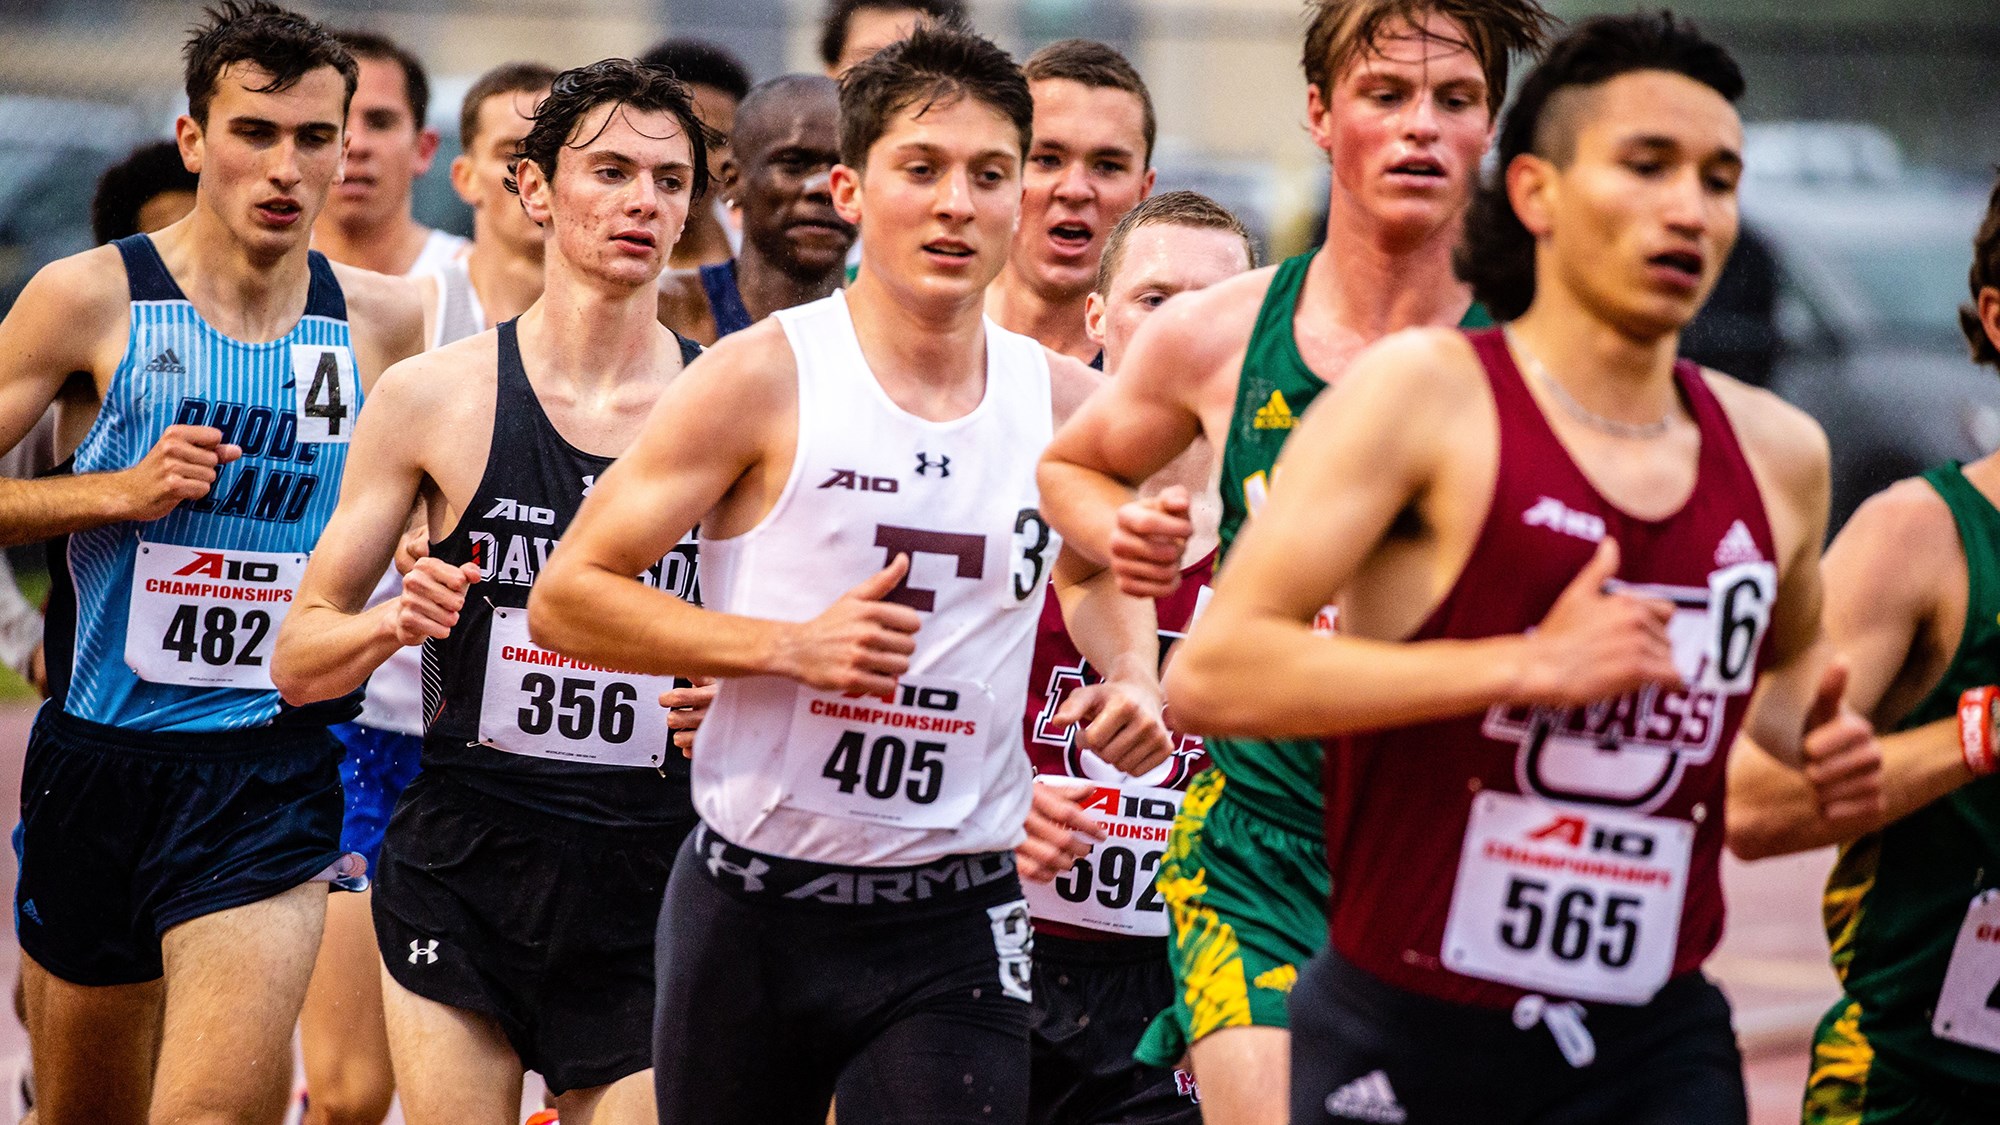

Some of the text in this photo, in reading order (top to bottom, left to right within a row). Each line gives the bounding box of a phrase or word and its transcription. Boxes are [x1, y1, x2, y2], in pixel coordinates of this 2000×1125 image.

[145, 363, 187, 375] adidas
[304, 352, 348, 436] 4
[817, 468, 899, 493] A10
[483, 497, 556, 526] A10
[173, 551, 278, 583] A10
[1013, 507, 1051, 601] 3
[145, 579, 293, 603] CHAMPIONSHIPS
[162, 604, 271, 667] 482
[1719, 579, 1762, 682] 6
[517, 672, 638, 744] 356
[810, 699, 976, 736] CHAMPIONSHIPS
[822, 730, 947, 805] 405
[1079, 787, 1176, 822] A10
[1527, 816, 1656, 858] A10
[1055, 844, 1166, 914] 592
[1500, 876, 1643, 968] 565
